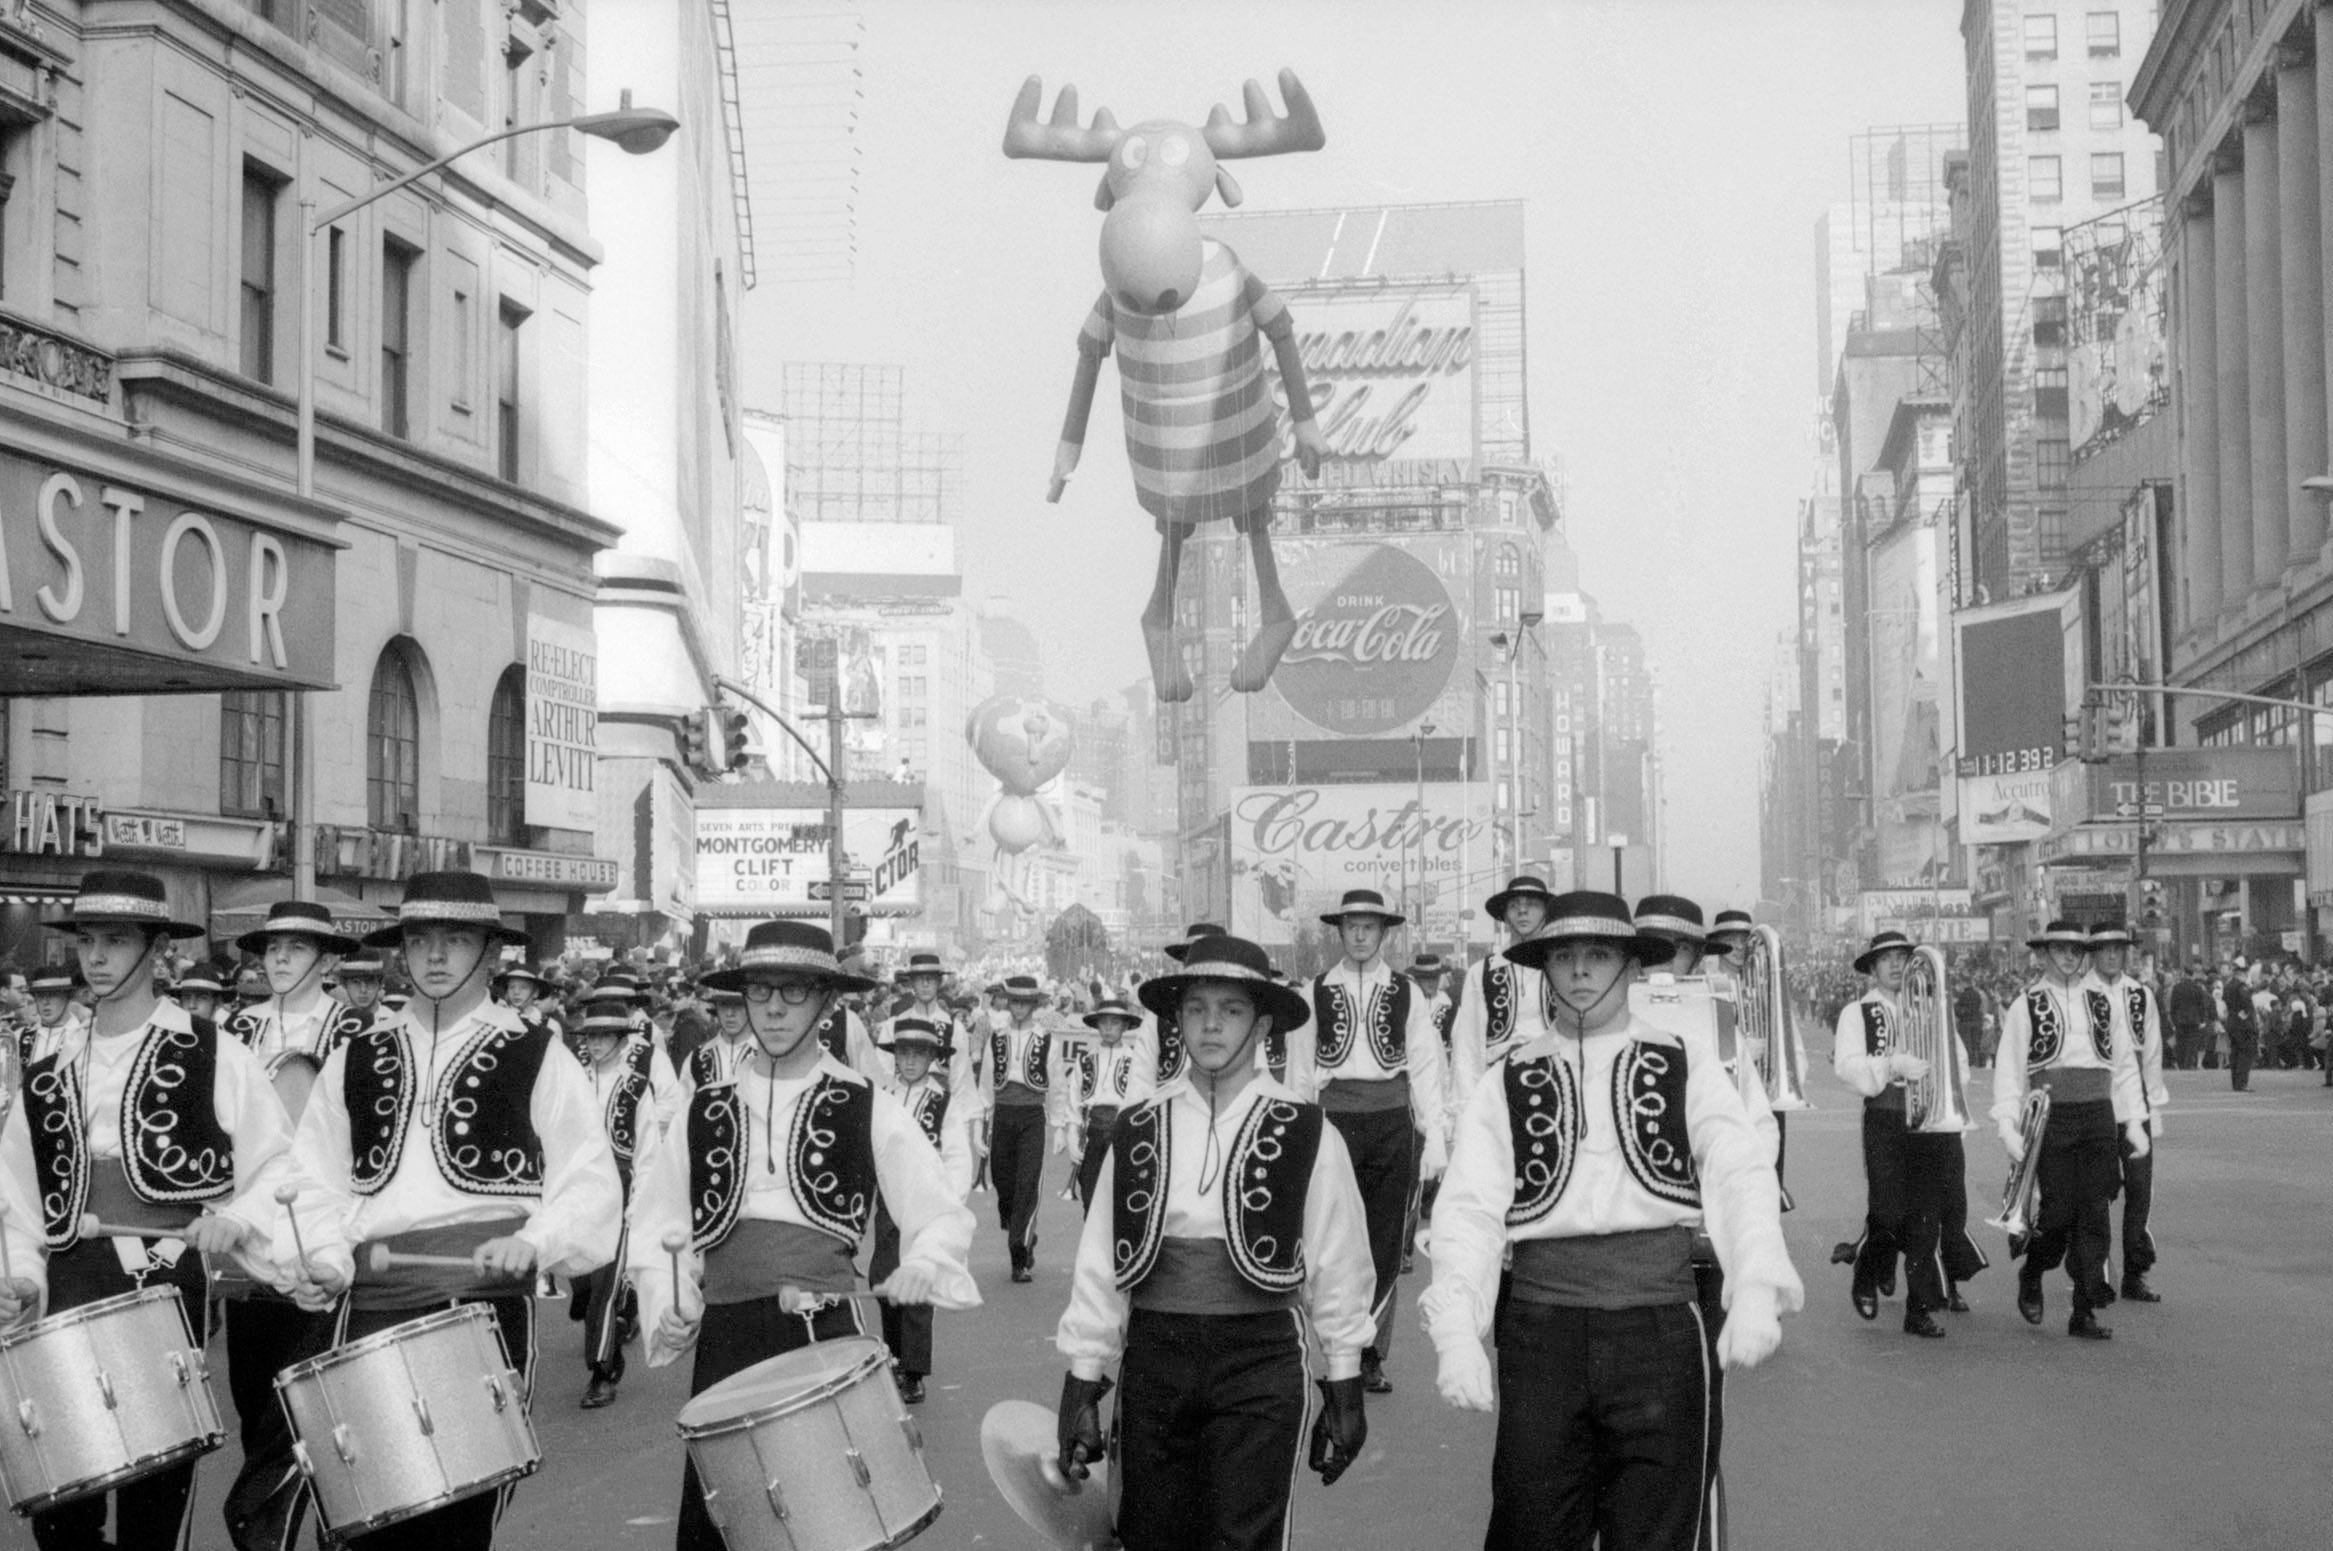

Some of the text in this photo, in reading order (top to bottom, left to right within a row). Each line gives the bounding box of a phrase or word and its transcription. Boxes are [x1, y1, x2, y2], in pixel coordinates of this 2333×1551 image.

[1369, 459, 1470, 487] WHISKY
[0, 472, 288, 670] STOR
[1336, 594, 1385, 607] DRINK
[530, 675, 597, 707] COMPTROLLER
[530, 698, 597, 748] ARTHUR
[529, 738, 597, 793] LEVITT
[1555, 690, 1571, 824] HOWARD
[1992, 781, 2050, 801] Accutro
[2167, 779, 2240, 808] BIBLE
[14, 790, 103, 857] HATS
[699, 823, 733, 832] SEVEN
[738, 823, 765, 832] ARTS
[1237, 789, 1484, 854] Castro
[696, 837, 824, 854] MONTGOMERY
[504, 854, 618, 883] COFFEE HOUSE
[733, 858, 794, 876] CLIFT
[845, 886, 862, 896] WAY
[335, 919, 378, 934] ASTOR
